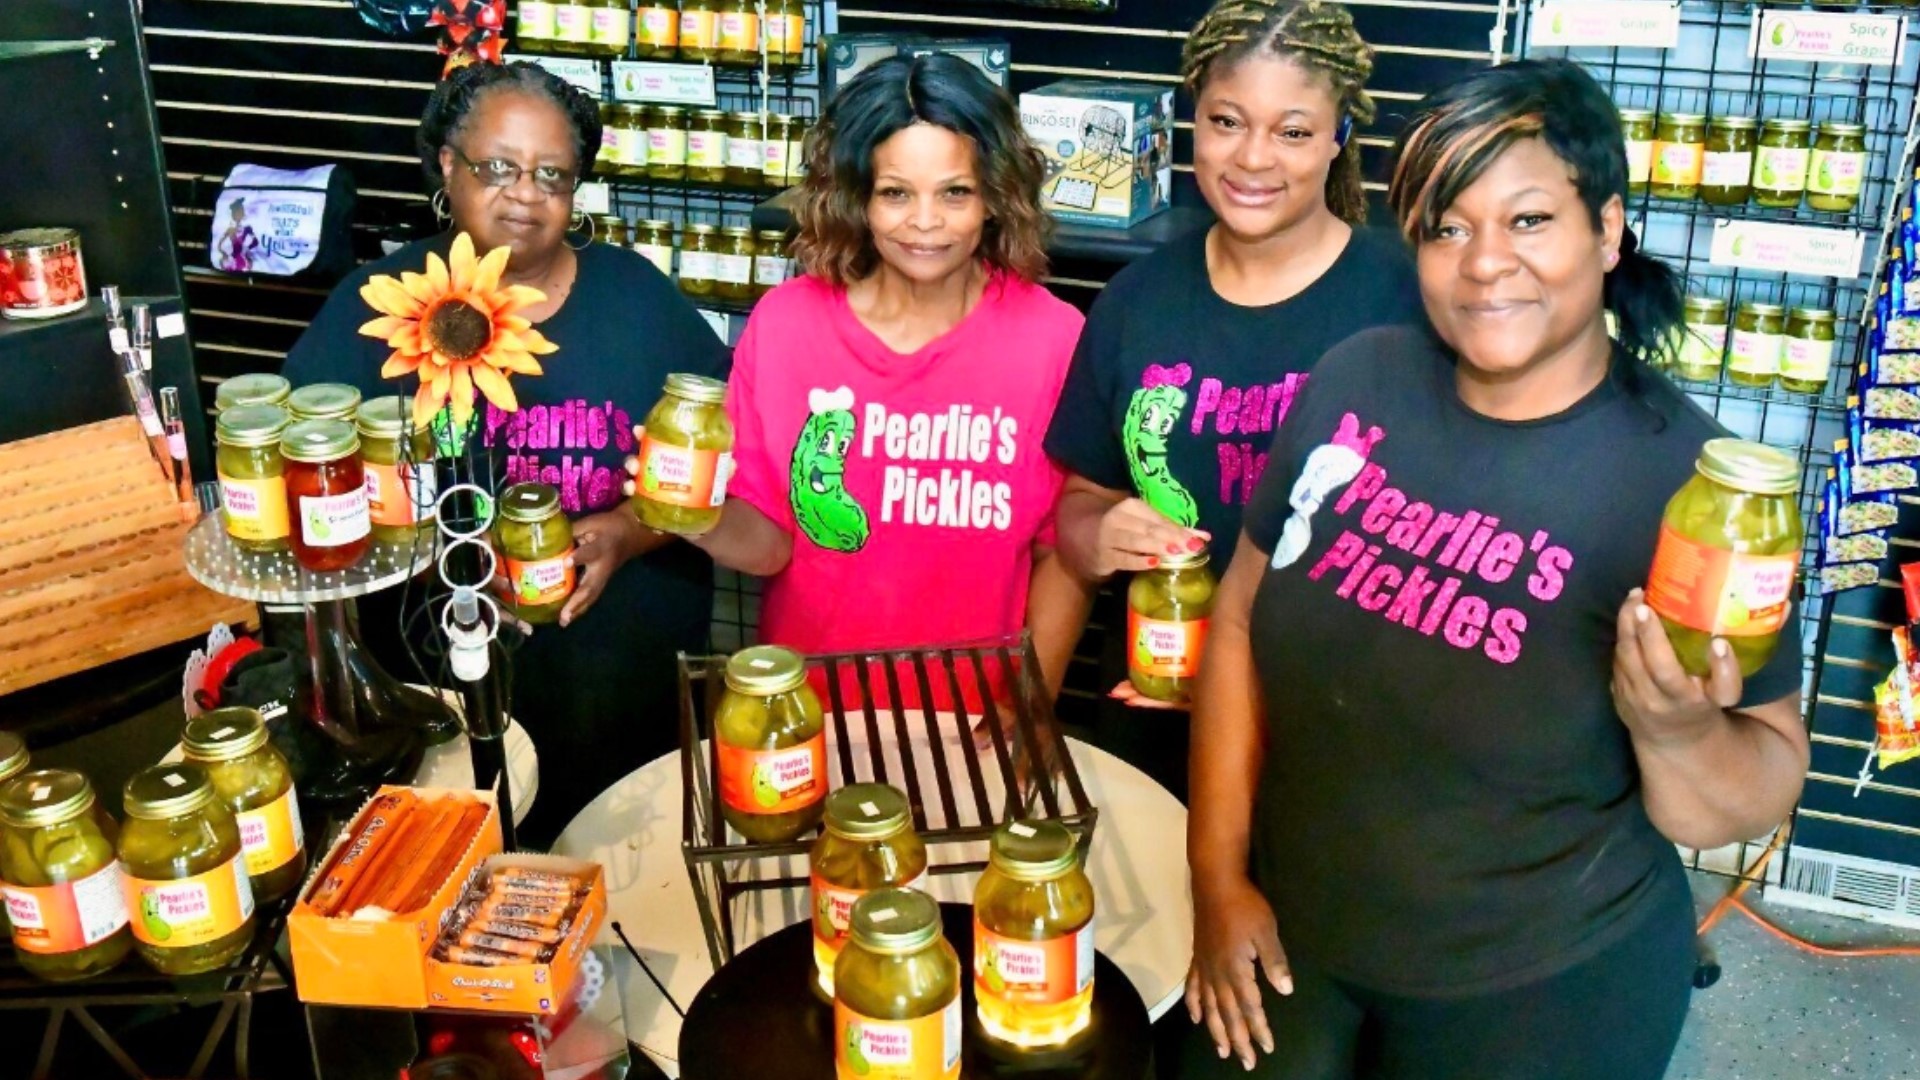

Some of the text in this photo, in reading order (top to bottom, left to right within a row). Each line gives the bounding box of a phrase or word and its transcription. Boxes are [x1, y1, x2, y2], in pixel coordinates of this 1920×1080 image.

[1849, 22, 1888, 39] Spicy
[1843, 43, 1888, 58] Grape
[1022, 113, 1076, 129] BINGO SET
[1191, 372, 1310, 436] Pearl
[484, 398, 633, 453] Pearlie's
[862, 402, 1018, 465] Pearlie's
[880, 465, 1012, 531] Pickles
[1334, 462, 1575, 601] Pearlie's
[1306, 530, 1528, 664] Pickles
[160, 888, 204, 904] Pearlie's
[863, 1029, 908, 1044] Pearlie's
[871, 1043, 908, 1056] Pickles
